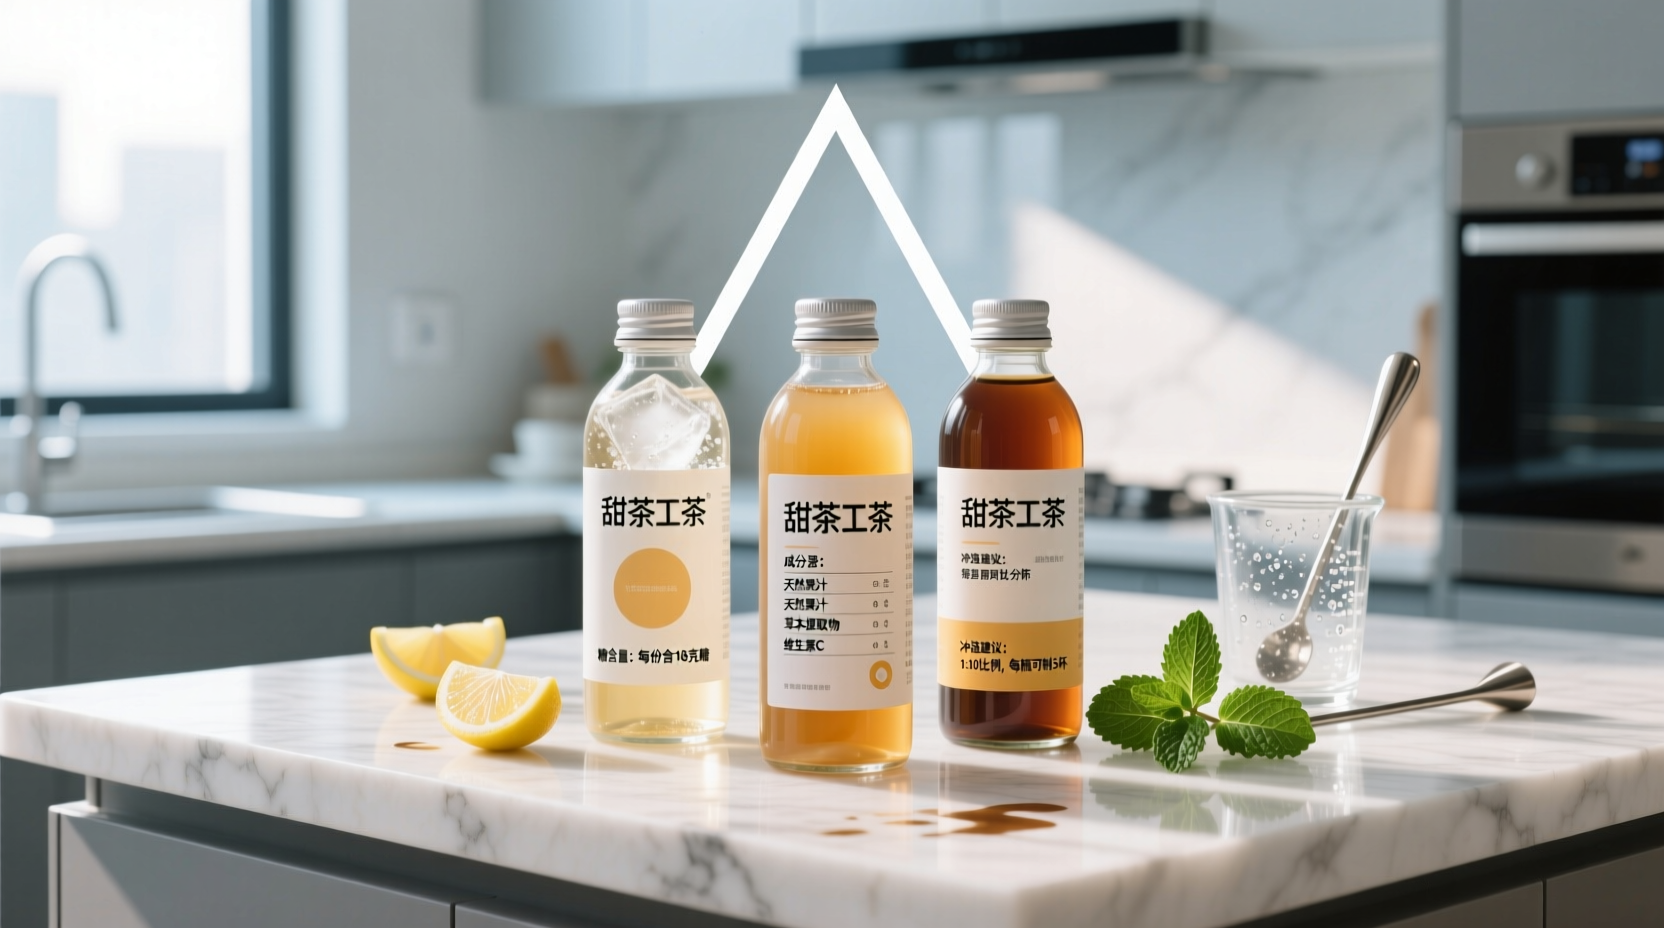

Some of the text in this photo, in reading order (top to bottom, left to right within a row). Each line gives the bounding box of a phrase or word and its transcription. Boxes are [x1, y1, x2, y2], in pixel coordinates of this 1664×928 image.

[601, 495, 706, 527] 甜茶工茶
[783, 500, 893, 534] 甜茶工茶
[961, 497, 1065, 528] 甜茶工茶
